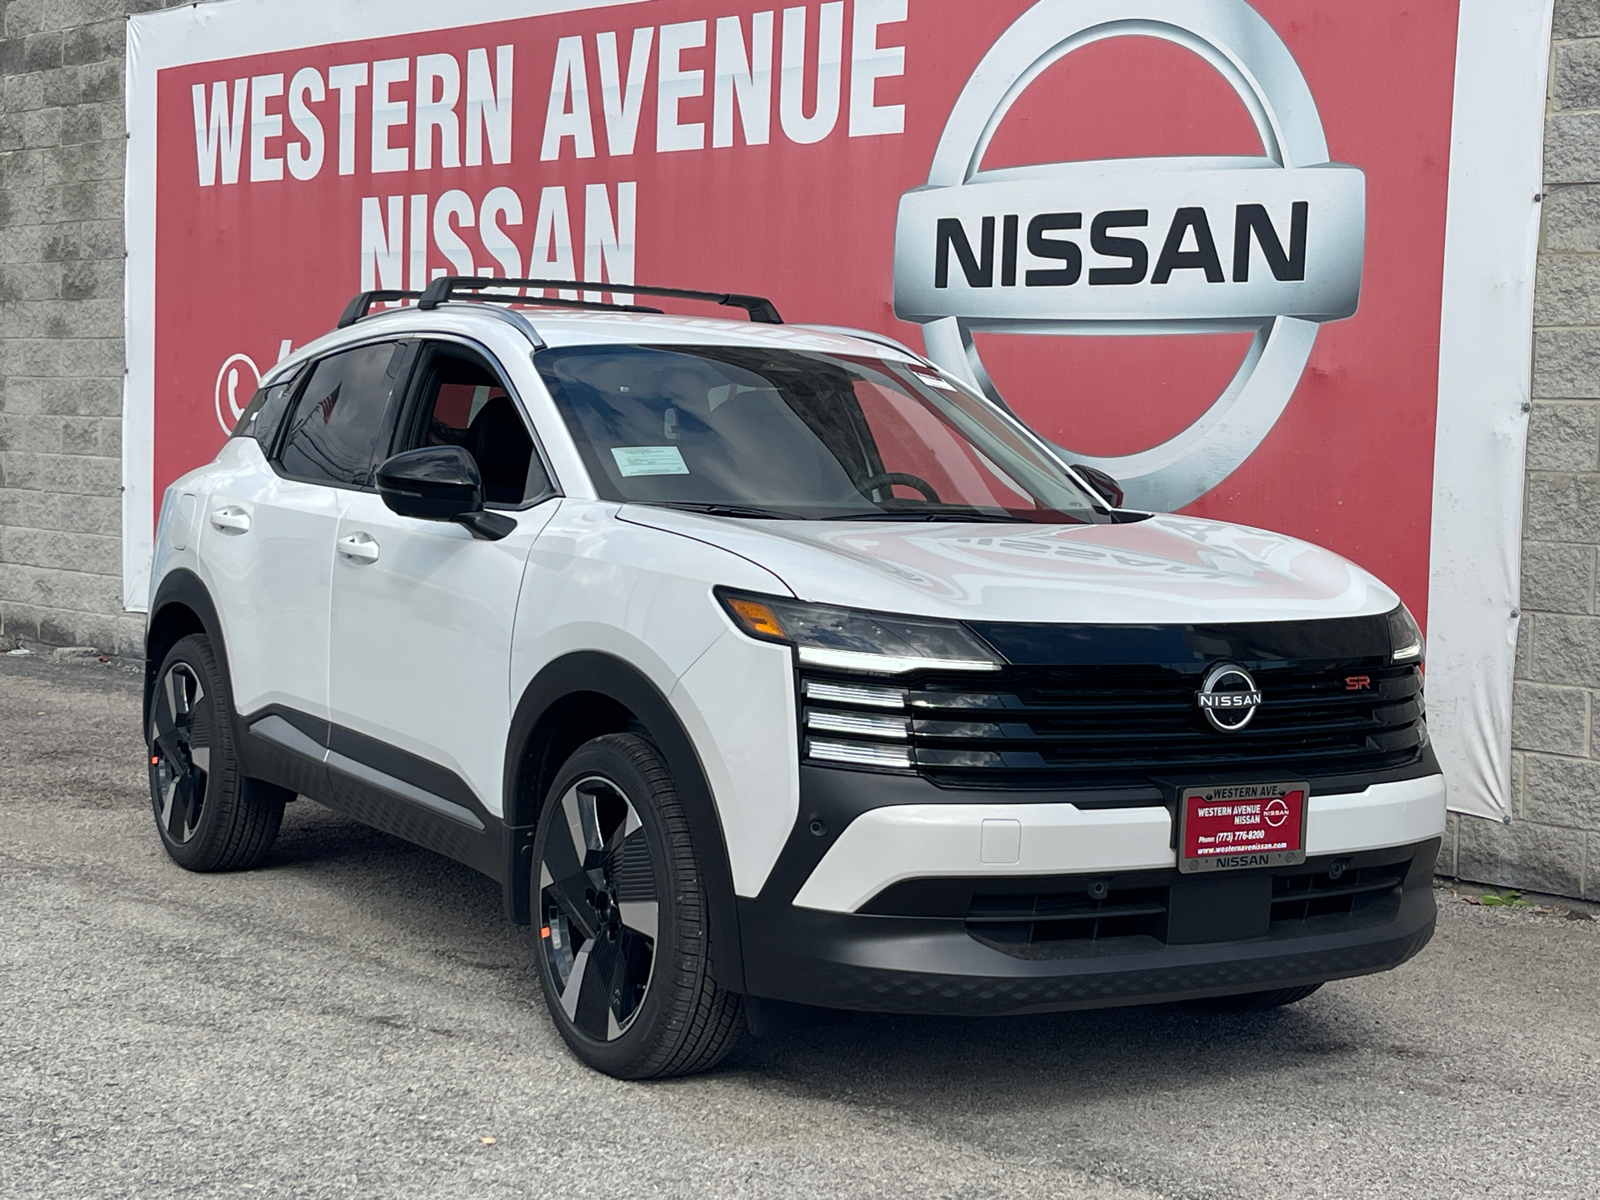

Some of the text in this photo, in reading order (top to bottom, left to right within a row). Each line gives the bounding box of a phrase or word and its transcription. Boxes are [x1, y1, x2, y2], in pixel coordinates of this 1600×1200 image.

[192, 0, 908, 187] WESTERN AVENUE
[361, 181, 638, 308] NISSAN
[935, 201, 1309, 288] NISSAN
[1345, 675, 1371, 690] SR
[1200, 694, 1261, 706] NISSAN
[1213, 787, 1258, 799] WESTERN
[1198, 804, 1261, 817] WESTERN AVENUE
[1234, 815, 1261, 825] NISSAN
[1216, 831, 1233, 844] (773)
[1234, 829, 1265, 841] 776-8200
[1216, 855, 1269, 868] NISSAN
